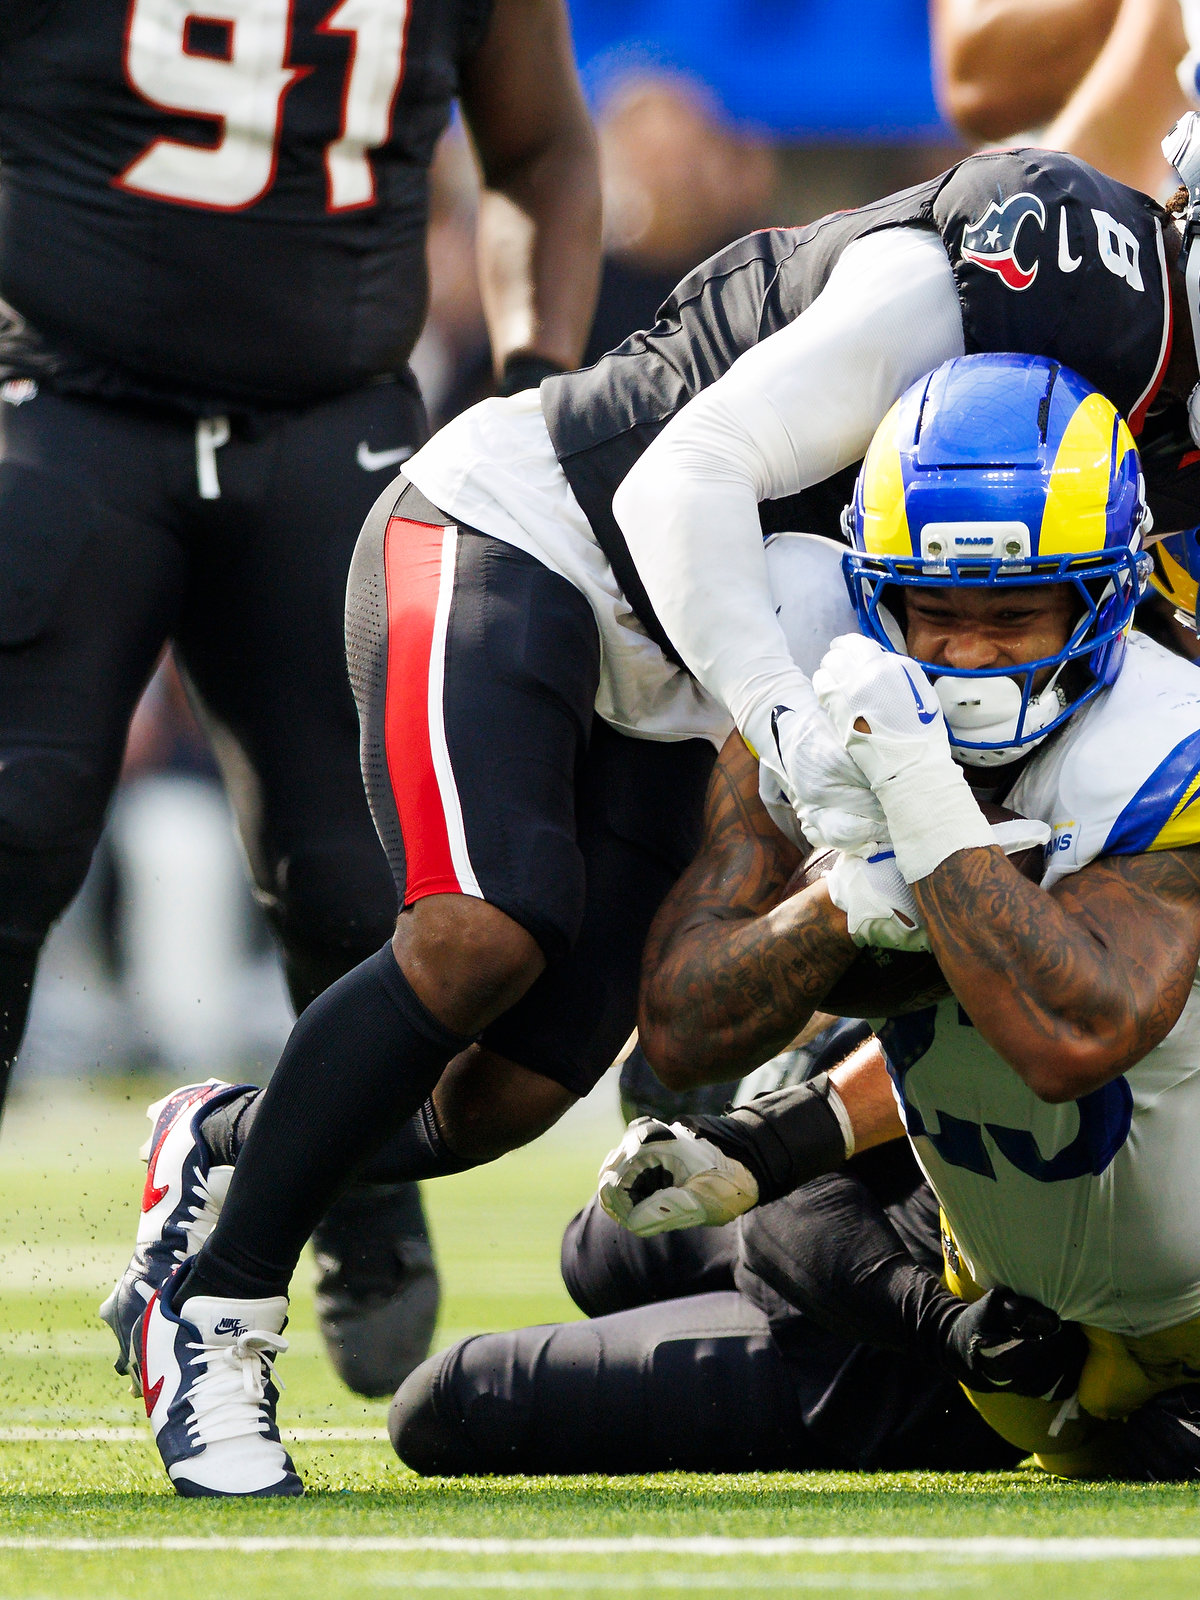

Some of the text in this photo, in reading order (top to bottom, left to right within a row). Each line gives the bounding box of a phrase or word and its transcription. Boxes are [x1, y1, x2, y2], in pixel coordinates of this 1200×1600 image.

[110, 0, 412, 214] 91
[1090, 208, 1146, 292] 8
[219, 1317, 242, 1329] NIKE
